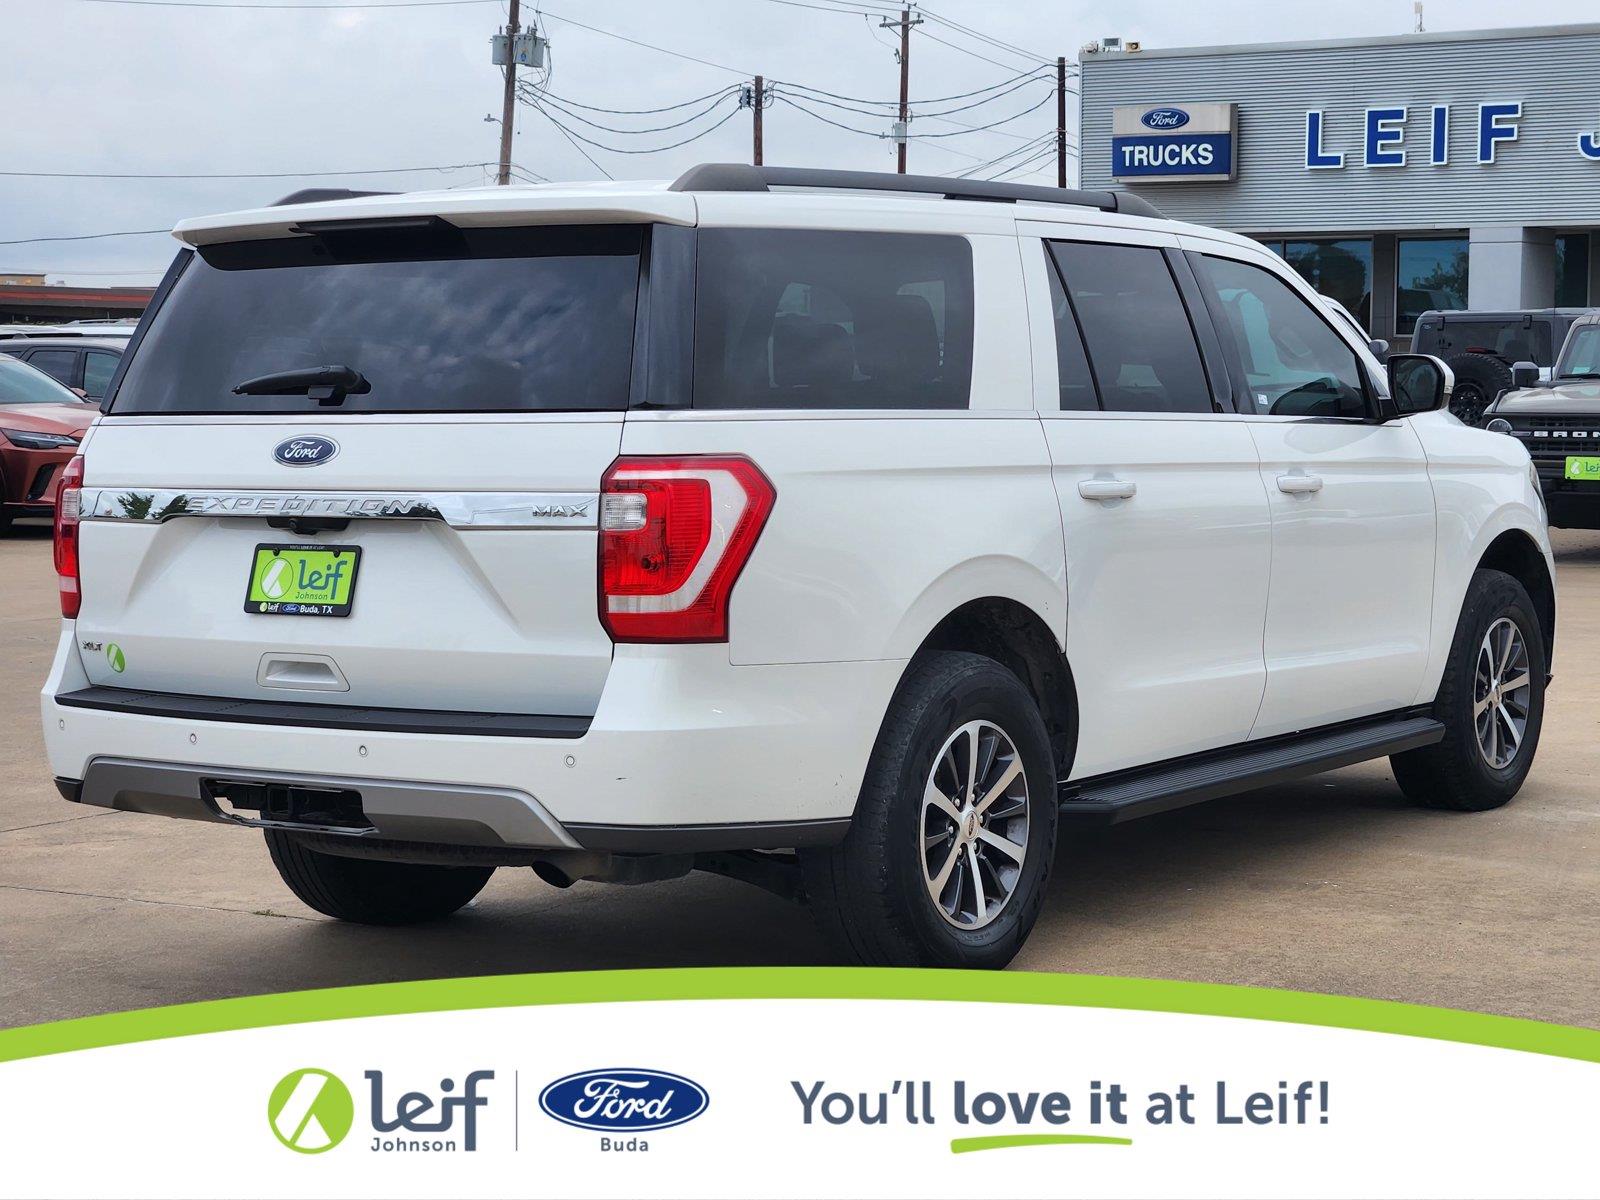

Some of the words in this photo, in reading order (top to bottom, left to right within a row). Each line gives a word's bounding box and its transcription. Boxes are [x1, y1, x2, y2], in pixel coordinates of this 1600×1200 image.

[1150, 111, 1179, 126] Ford
[1305, 101, 1523, 169] LEIF
[1121, 143, 1214, 167] TRUCKS
[284, 440, 323, 459] Ford
[1585, 461, 1600, 473] lei
[184, 496, 415, 515] EXPEDITION
[532, 504, 588, 518] MAX
[298, 559, 348, 600] leif
[295, 591, 328, 601] Johnson
[299, 604, 320, 615] Buda,
[322, 605, 334, 614] TX
[82, 640, 103, 651] XLT
